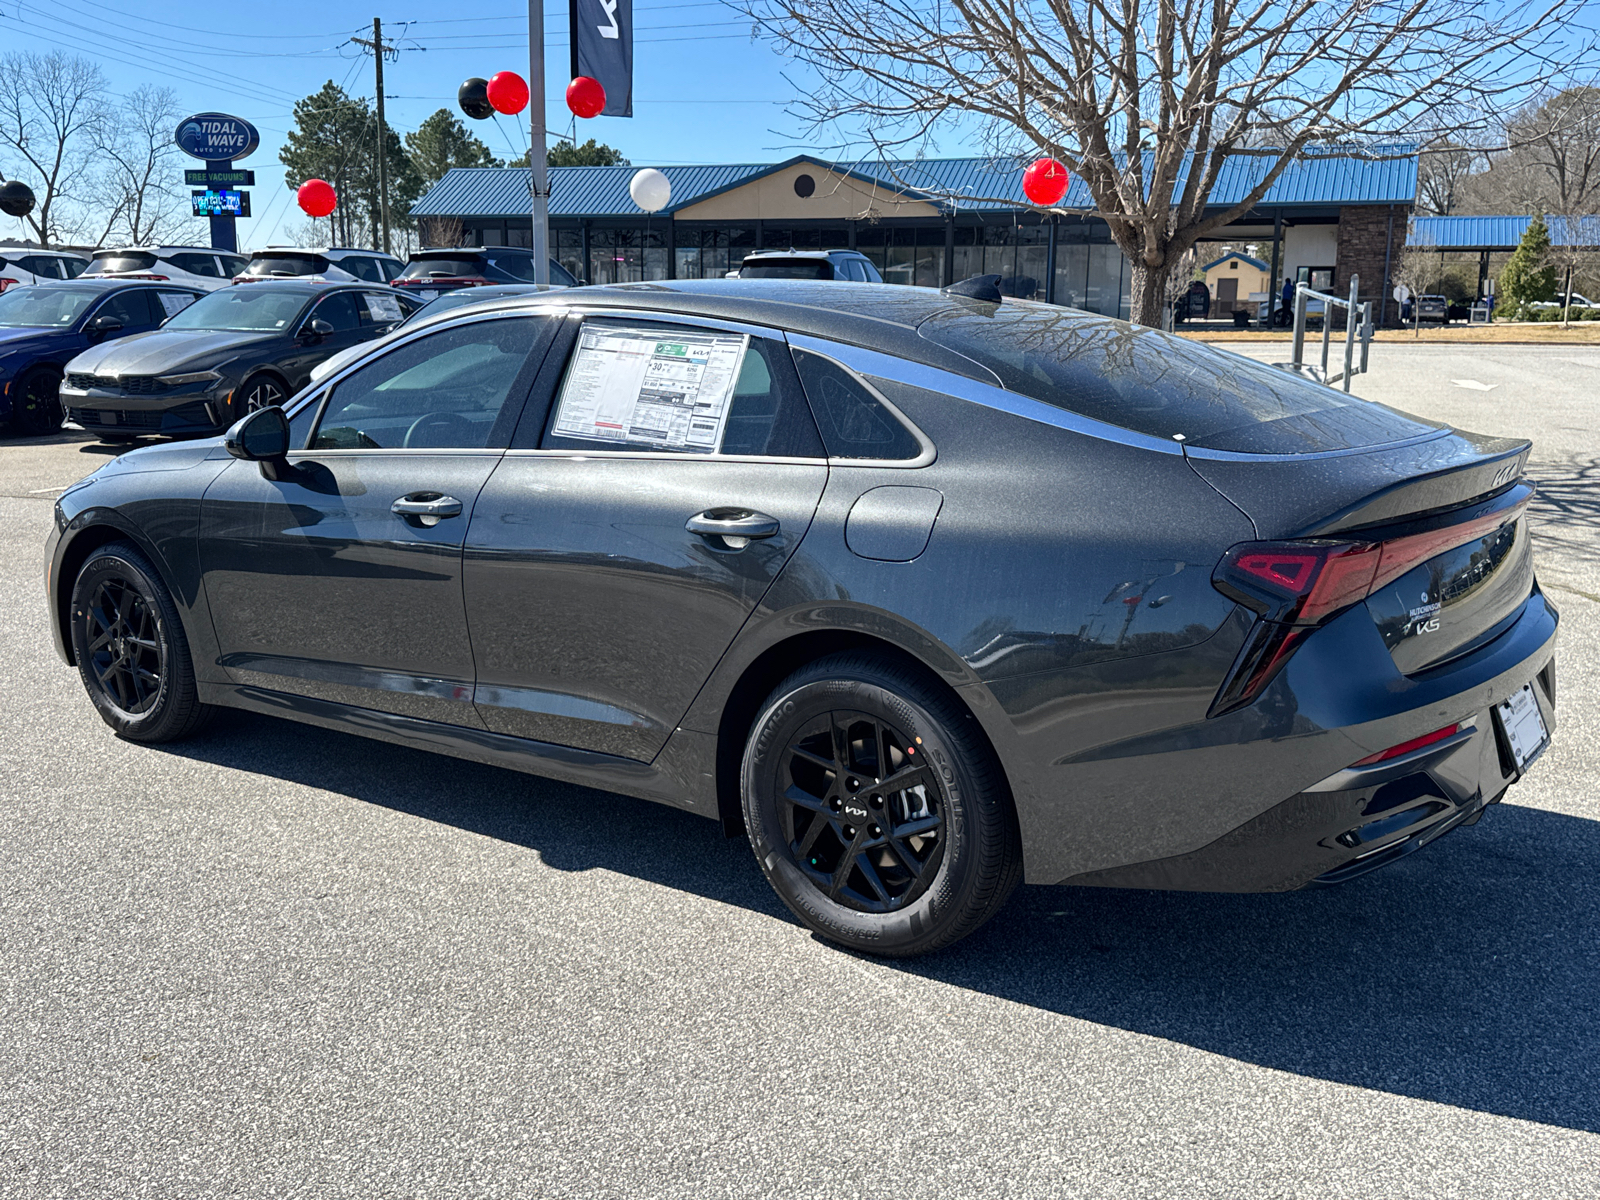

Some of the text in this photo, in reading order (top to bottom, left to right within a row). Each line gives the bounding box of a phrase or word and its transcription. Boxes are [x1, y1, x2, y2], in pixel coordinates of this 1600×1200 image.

[201, 122, 237, 134] TIDAL
[207, 134, 244, 146] WAVE
[187, 173, 244, 181] FREE VACUUMS
[652, 362, 663, 371] 30
[90, 558, 122, 575] KUMHO
[1410, 602, 1441, 617] HUTCHINSON
[1416, 618, 1440, 635] K5
[753, 701, 796, 766] KUMHO
[931, 747, 965, 834] SOLUS
